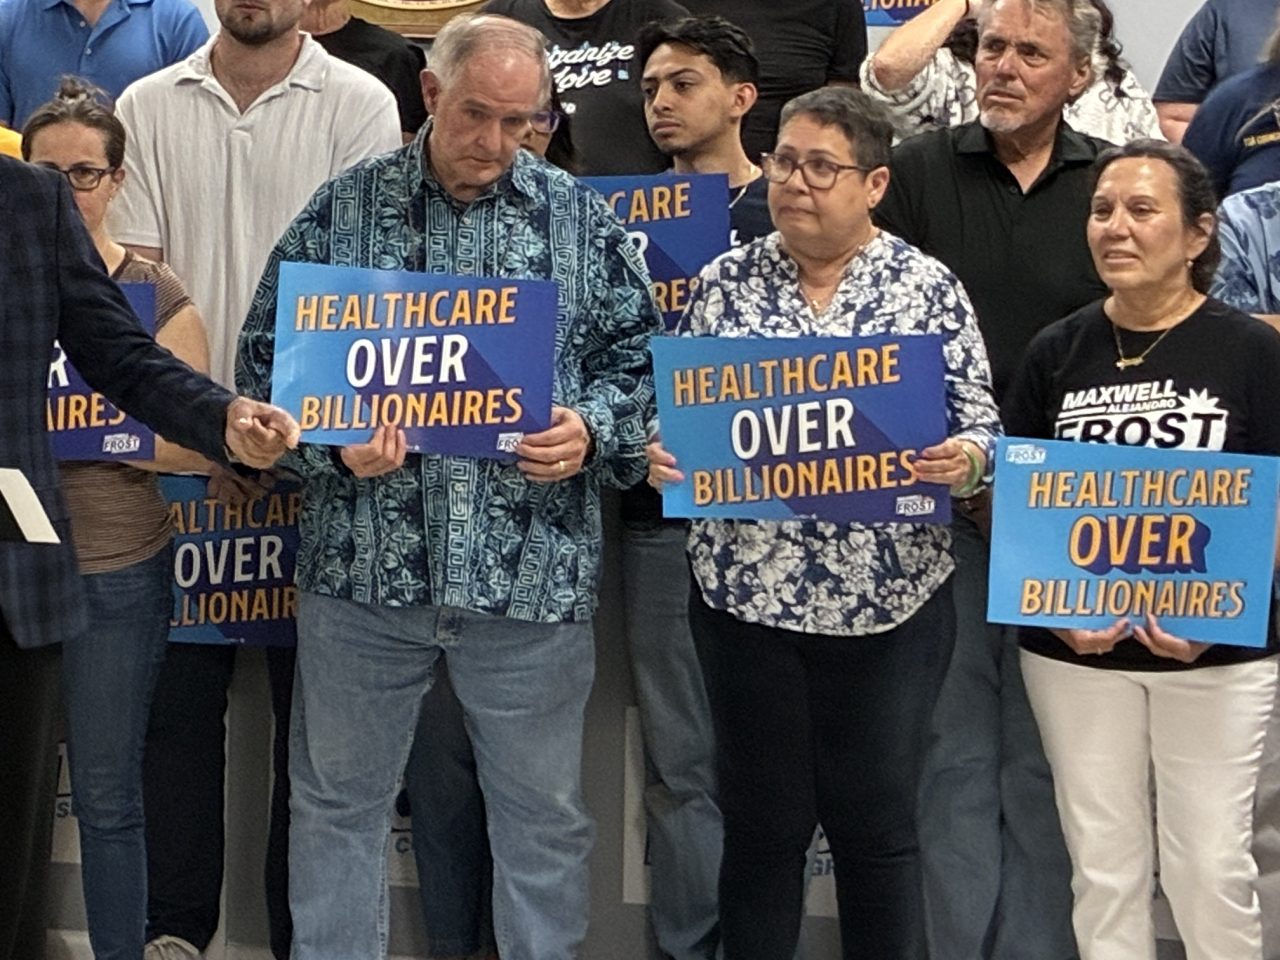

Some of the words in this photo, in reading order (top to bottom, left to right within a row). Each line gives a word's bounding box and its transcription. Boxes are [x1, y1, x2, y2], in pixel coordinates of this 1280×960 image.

[295, 287, 519, 331] HEALTHCARE
[345, 334, 469, 388] OVER
[673, 343, 902, 407] HEALTHCARE
[300, 388, 523, 431] BILLIONAIRES
[1061, 379, 1178, 410] MAXWELL
[1106, 398, 1177, 413] ALEJANDRO
[730, 396, 857, 461] OVER
[693, 448, 920, 507] BILLIONAIRES
[1027, 468, 1253, 508] HEALTHCARE
[174, 535, 283, 588] OVER
[1069, 513, 1197, 567] OVER
[1020, 578, 1247, 618] BILLIONAIRES
